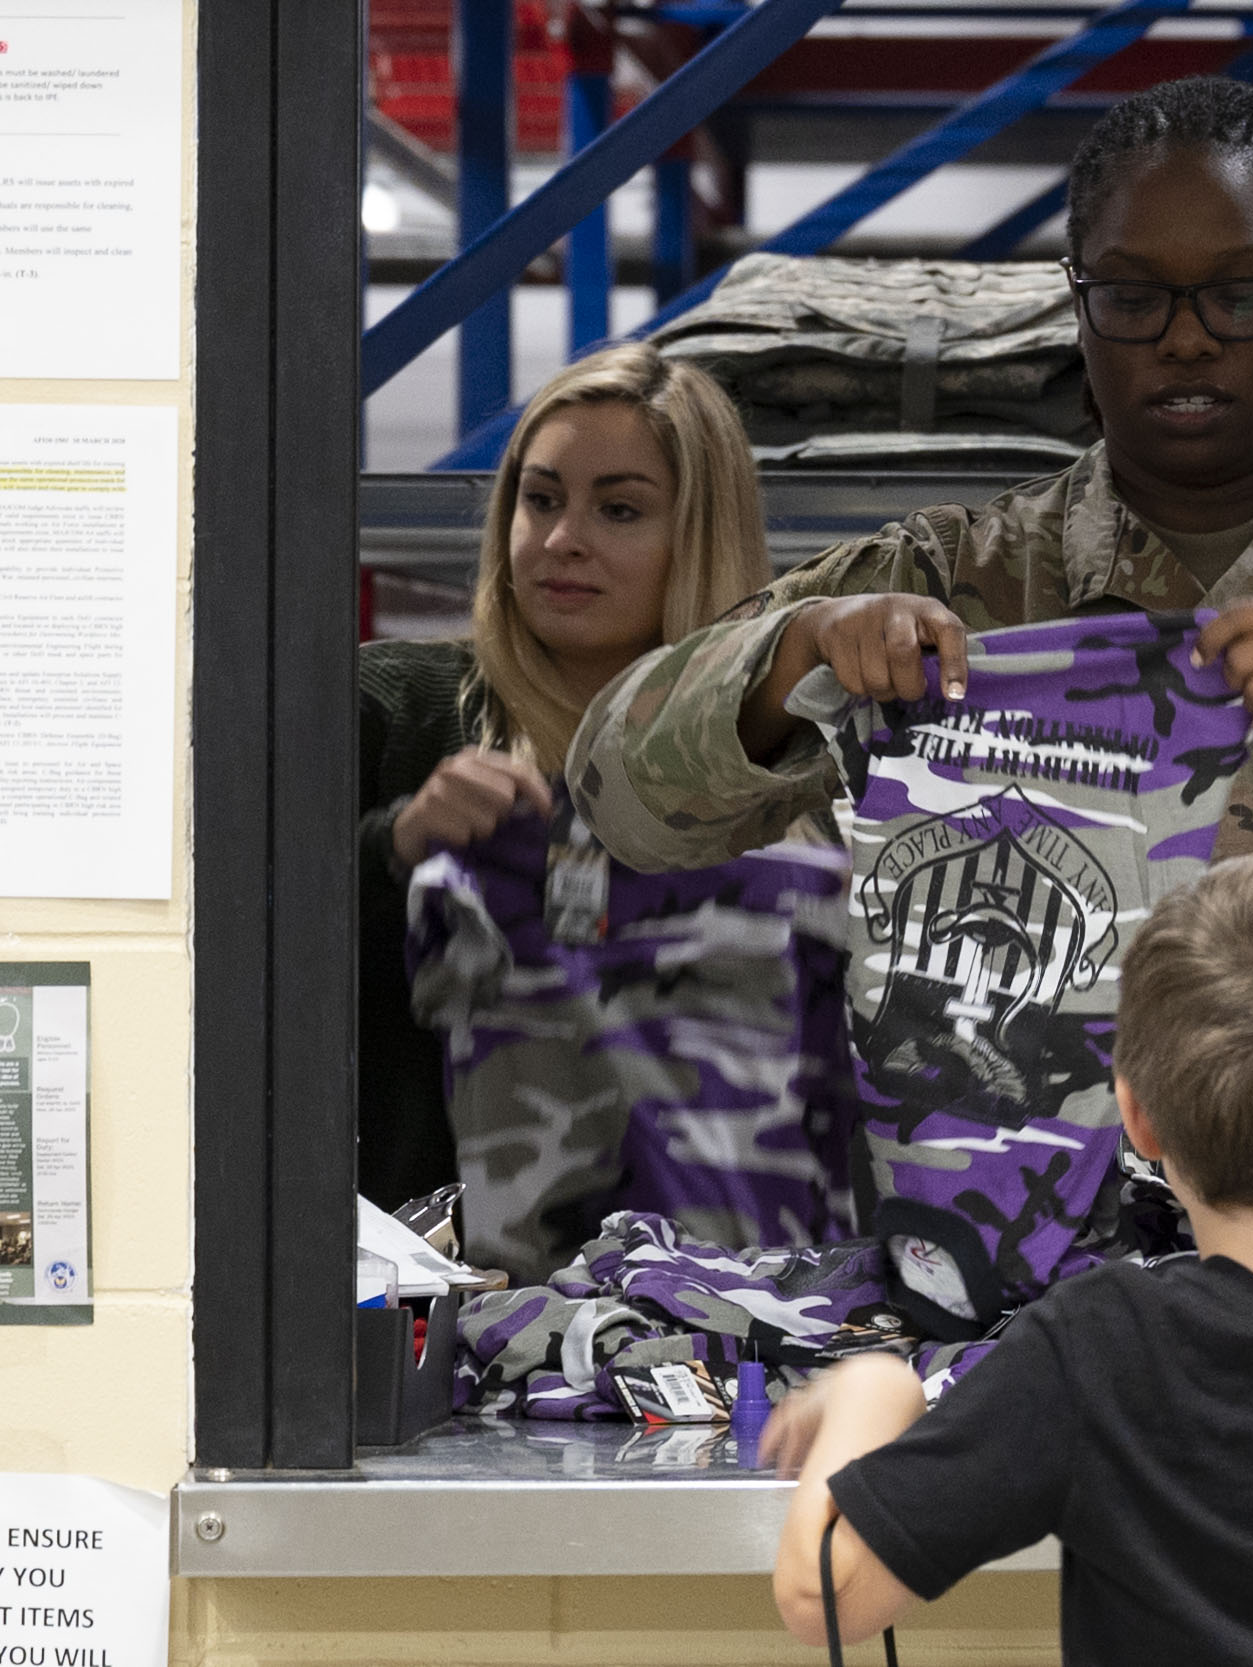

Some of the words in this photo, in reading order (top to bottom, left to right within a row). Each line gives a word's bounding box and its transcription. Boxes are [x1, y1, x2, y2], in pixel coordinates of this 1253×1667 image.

[904, 728, 972, 769] FIEL
[957, 798, 1002, 844] ANY
[1017, 809, 1070, 871] TIME
[882, 822, 951, 880] PLACE
[1066, 862, 1112, 914] ANY
[8, 1527, 103, 1550] ENSURE
[13, 1567, 65, 1588] YOU
[20, 1606, 94, 1628] ITEMS
[54, 1647, 112, 1667] WILL
